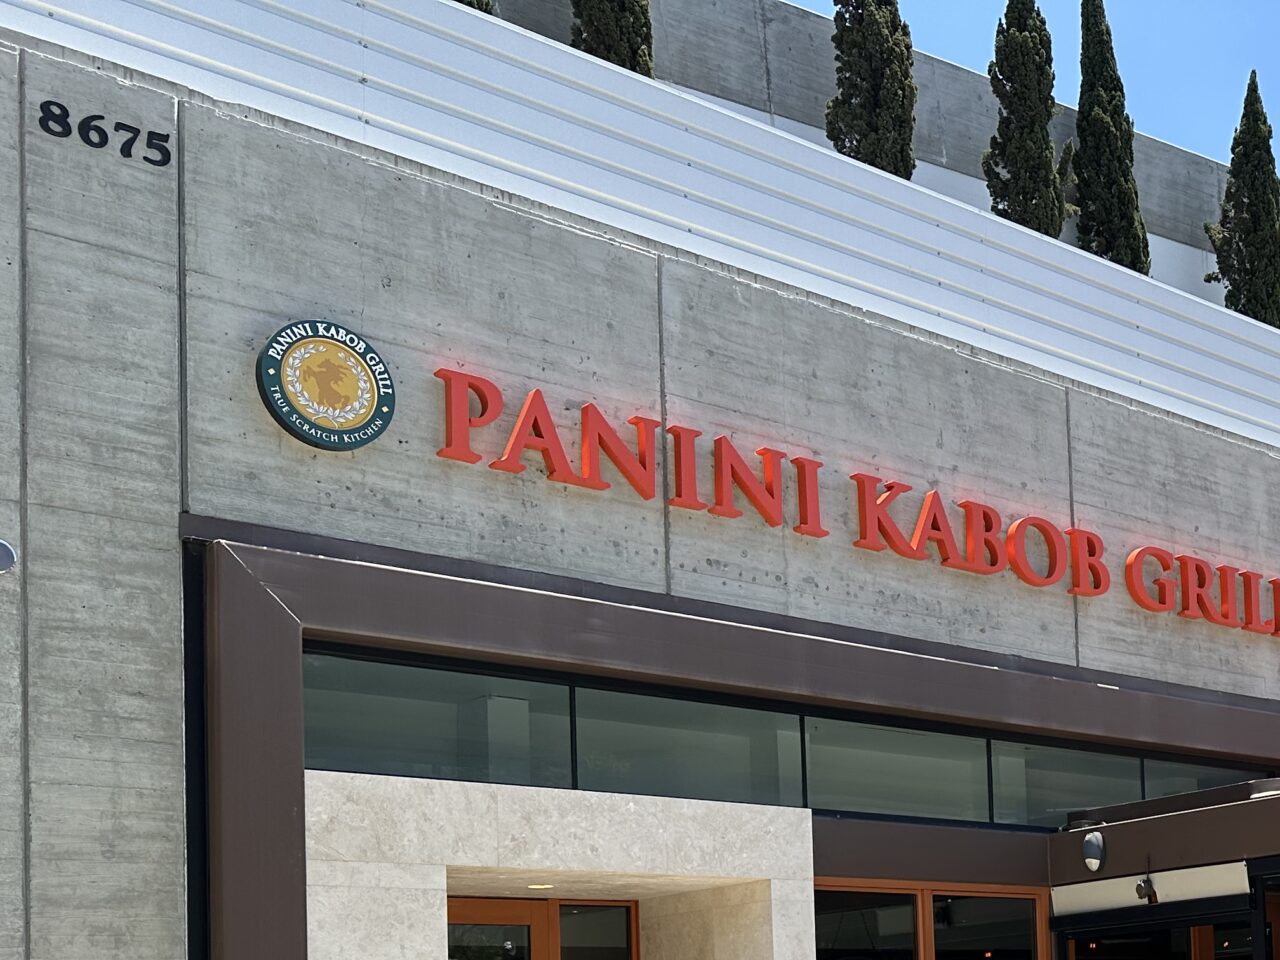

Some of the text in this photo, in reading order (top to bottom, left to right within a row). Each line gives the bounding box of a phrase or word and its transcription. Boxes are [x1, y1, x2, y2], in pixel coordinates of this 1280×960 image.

[39, 100, 171, 167] 8675
[268, 323, 393, 396] PANINI KABOB GRILL
[270, 384, 383, 443] TRUE SCRATCH KITCHEN
[433, 367, 830, 538] PANINI
[849, 472, 1110, 597] KABOB
